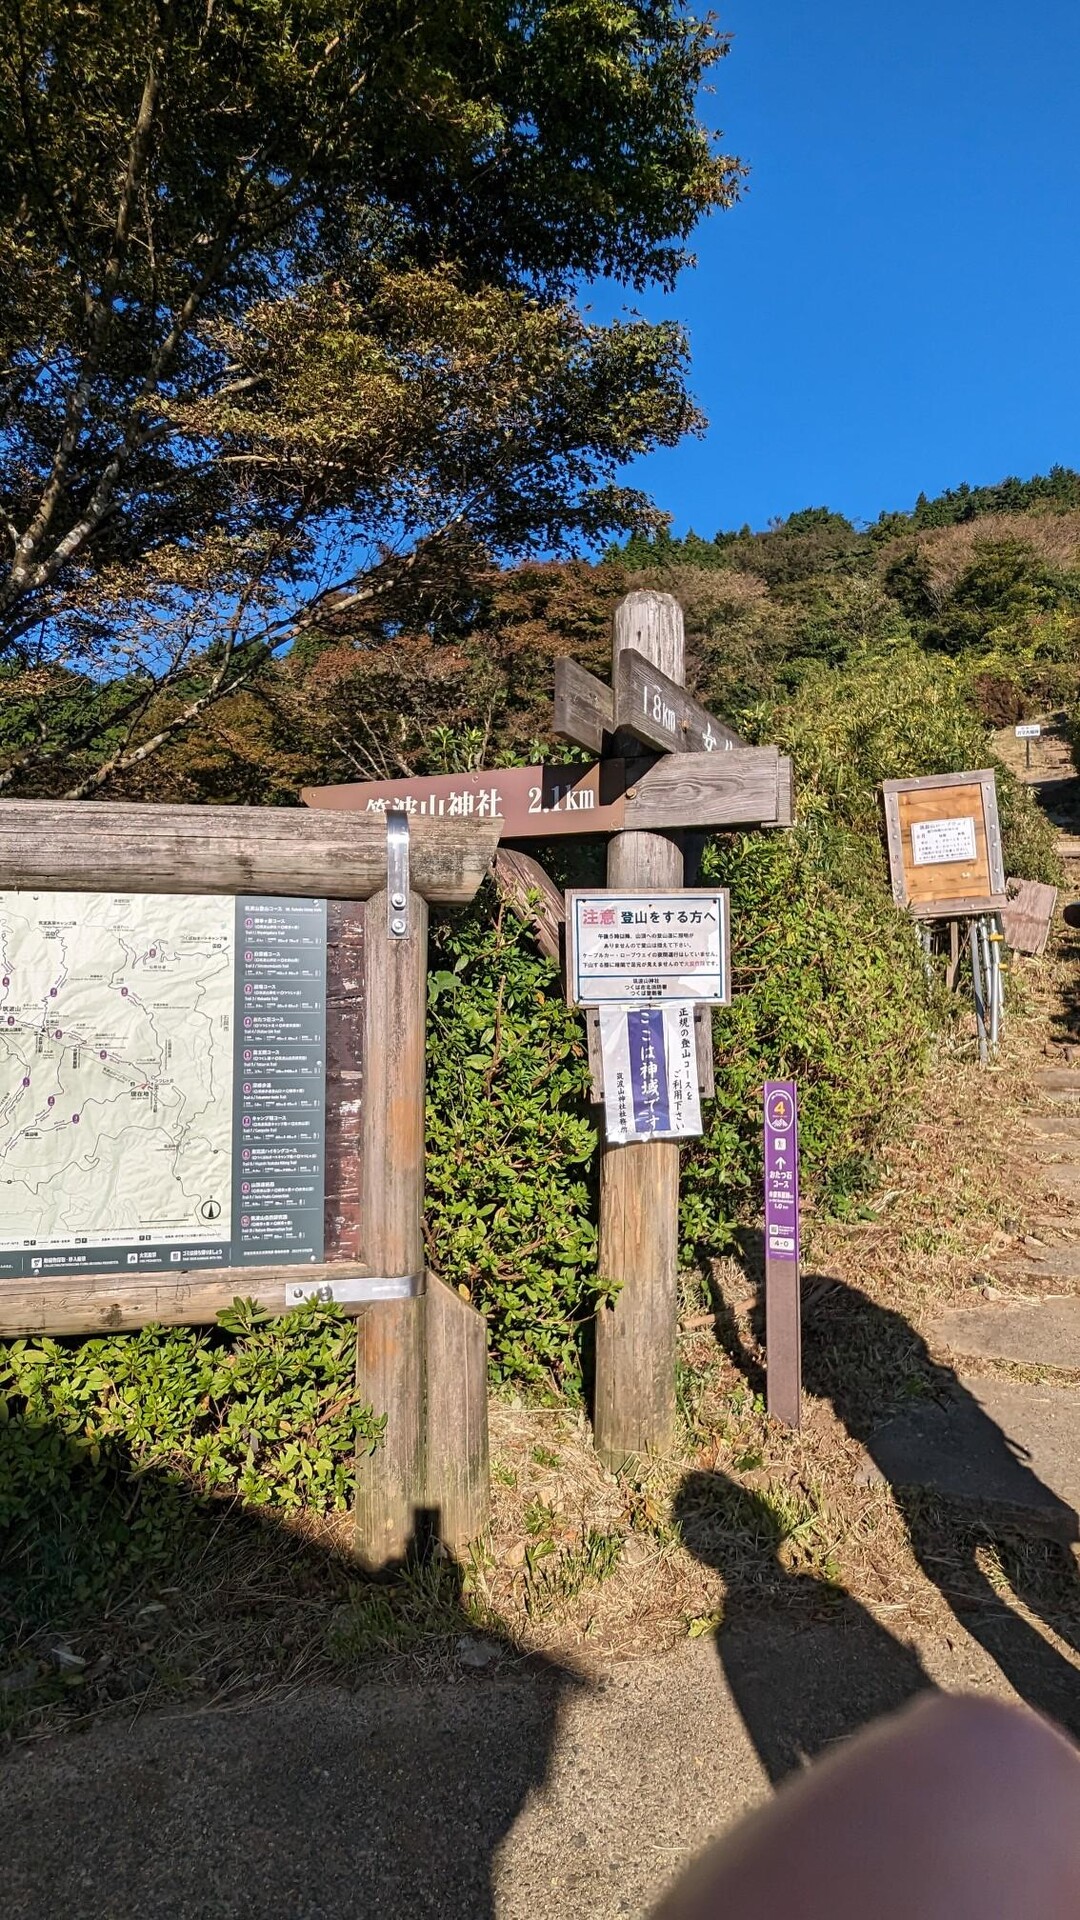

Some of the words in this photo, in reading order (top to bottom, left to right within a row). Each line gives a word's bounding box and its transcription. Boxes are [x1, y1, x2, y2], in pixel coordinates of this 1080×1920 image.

[582, 908, 616, 925] 注意
[620, 910, 717, 925] 登山をする方へ
[678, 1007, 693, 1101] 正規の登山コースを
[640, 1012, 660, 1132] ここは神域です
[672, 1069, 685, 1131] ご利用下さい
[774, 1101, 786, 1115] 4
[769, 1171, 793, 1180] おたつ石
[773, 1180, 790, 1189] コース
